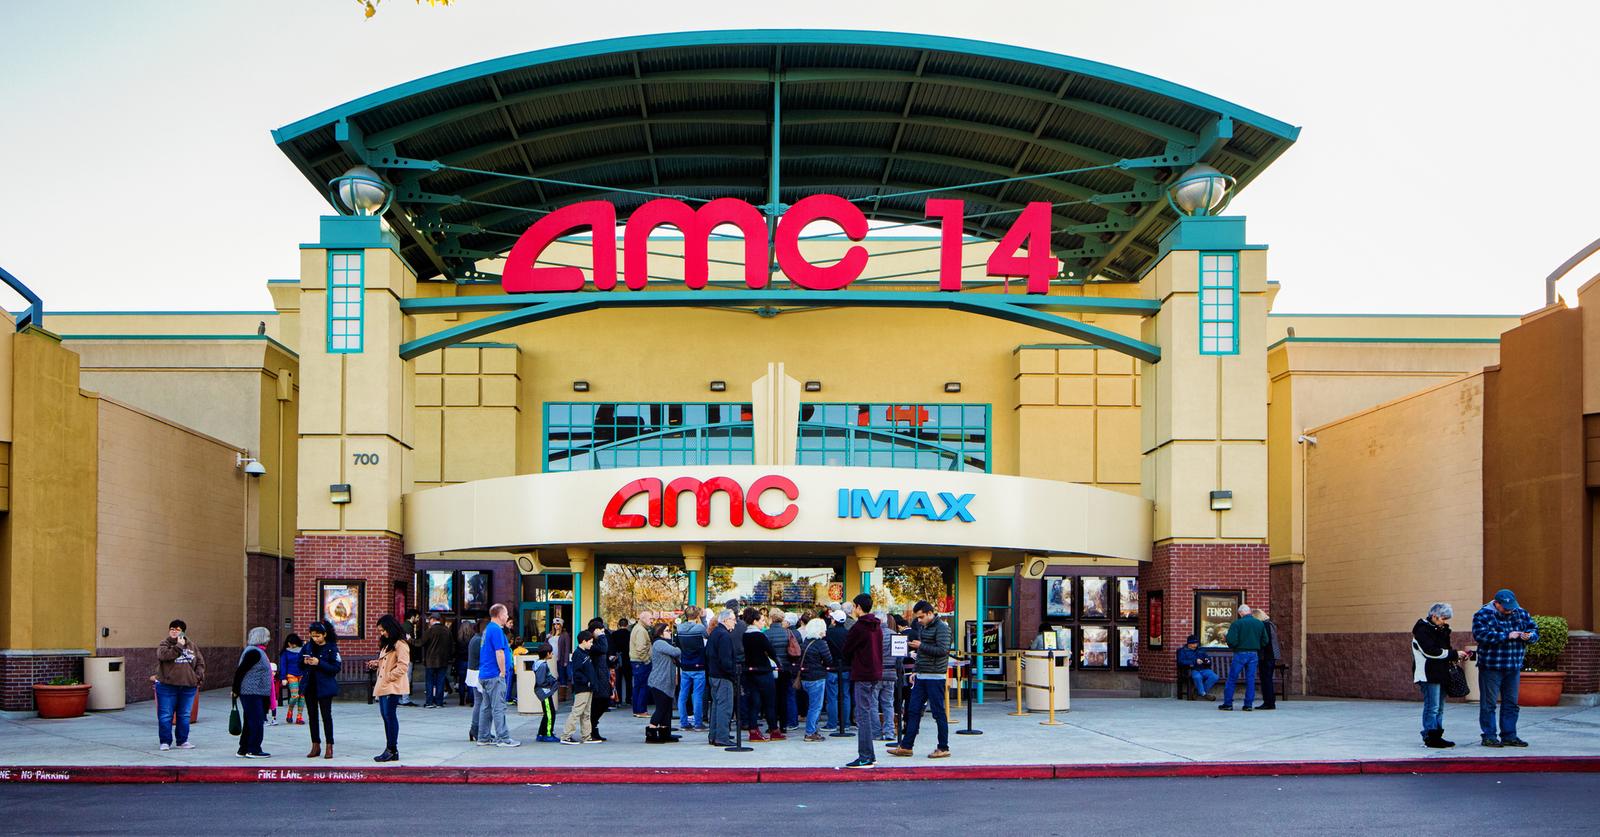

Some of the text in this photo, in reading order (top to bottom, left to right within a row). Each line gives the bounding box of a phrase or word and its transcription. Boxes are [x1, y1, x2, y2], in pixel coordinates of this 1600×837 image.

[925, 199, 1059, 294] 14
[352, 453, 380, 466] 700
[836, 488, 977, 523] IMAX
[1206, 607, 1232, 617] FENCES
[21, 770, 33, 780] NO
[36, 770, 70, 780] PARKING
[257, 769, 277, 779] FIRE
[280, 769, 303, 779] LANE
